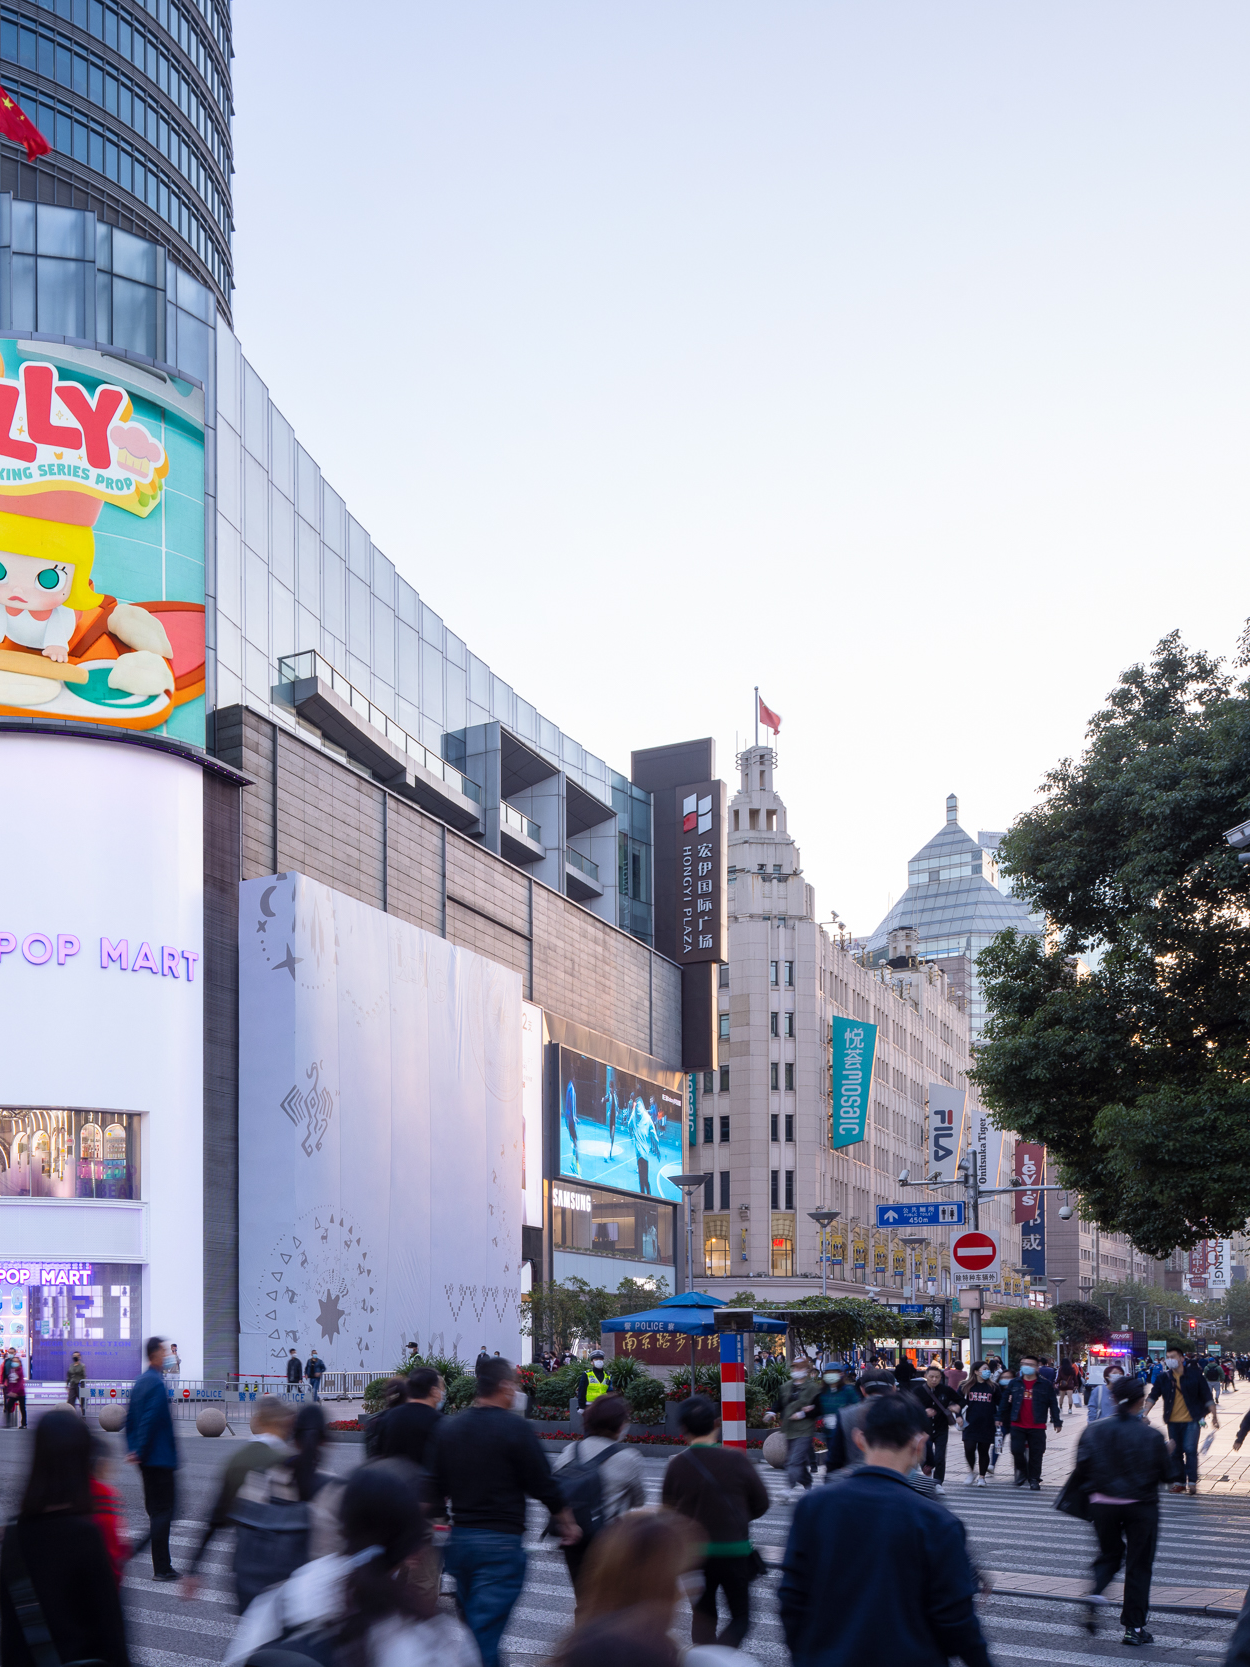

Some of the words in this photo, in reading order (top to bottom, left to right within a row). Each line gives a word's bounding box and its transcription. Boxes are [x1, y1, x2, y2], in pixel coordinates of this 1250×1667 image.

[37, 463, 90, 481] SERIES
[94, 473, 133, 491] PROP
[682, 846, 693, 901] HONGYI
[697, 843, 713, 949] 宏伊国际广场
[682, 908, 693, 954] PLAZA
[100, 937, 199, 982] MART
[838, 1070, 863, 1135] mosaic
[933, 1109, 954, 1162] FILA
[977, 1117, 989, 1142] Tiger
[978, 1143, 987, 1185] Onitsuka
[1021, 1154, 1037, 1206] Levi's
[553, 1188, 592, 1212] SAMSUNG
[908, 1216, 929, 1224] 450m
[41, 1269, 92, 1286] MART
[955, 1273, 996, 1283] 除特种车辆外
[634, 1321, 664, 1331] POLICE
[196, 1390, 223, 1398] POLICE
[277, 1393, 306, 1403] POLICE
